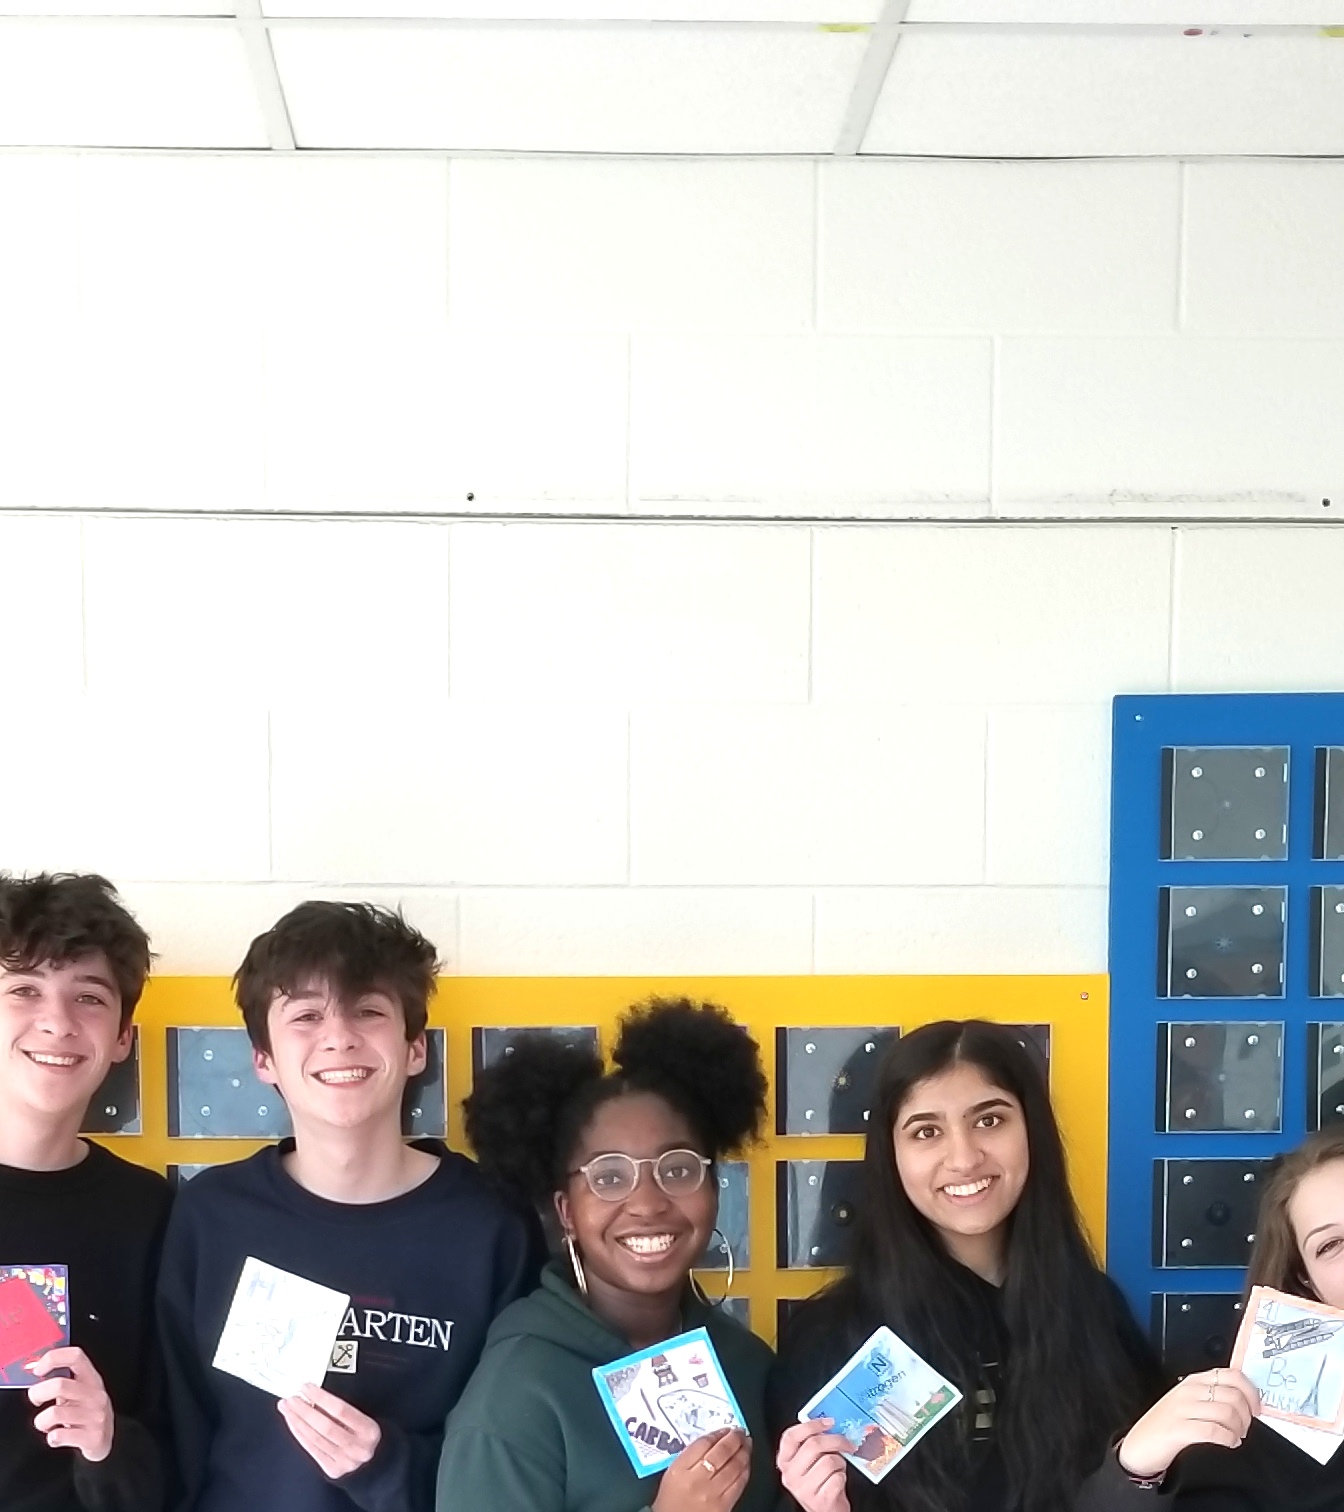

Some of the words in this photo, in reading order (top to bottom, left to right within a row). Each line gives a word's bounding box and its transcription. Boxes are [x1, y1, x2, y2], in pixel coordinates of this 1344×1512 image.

[337, 1307, 454, 1351] ARTEN
[871, 1356, 887, 1372] N
[1267, 1356, 1297, 1391] Be
